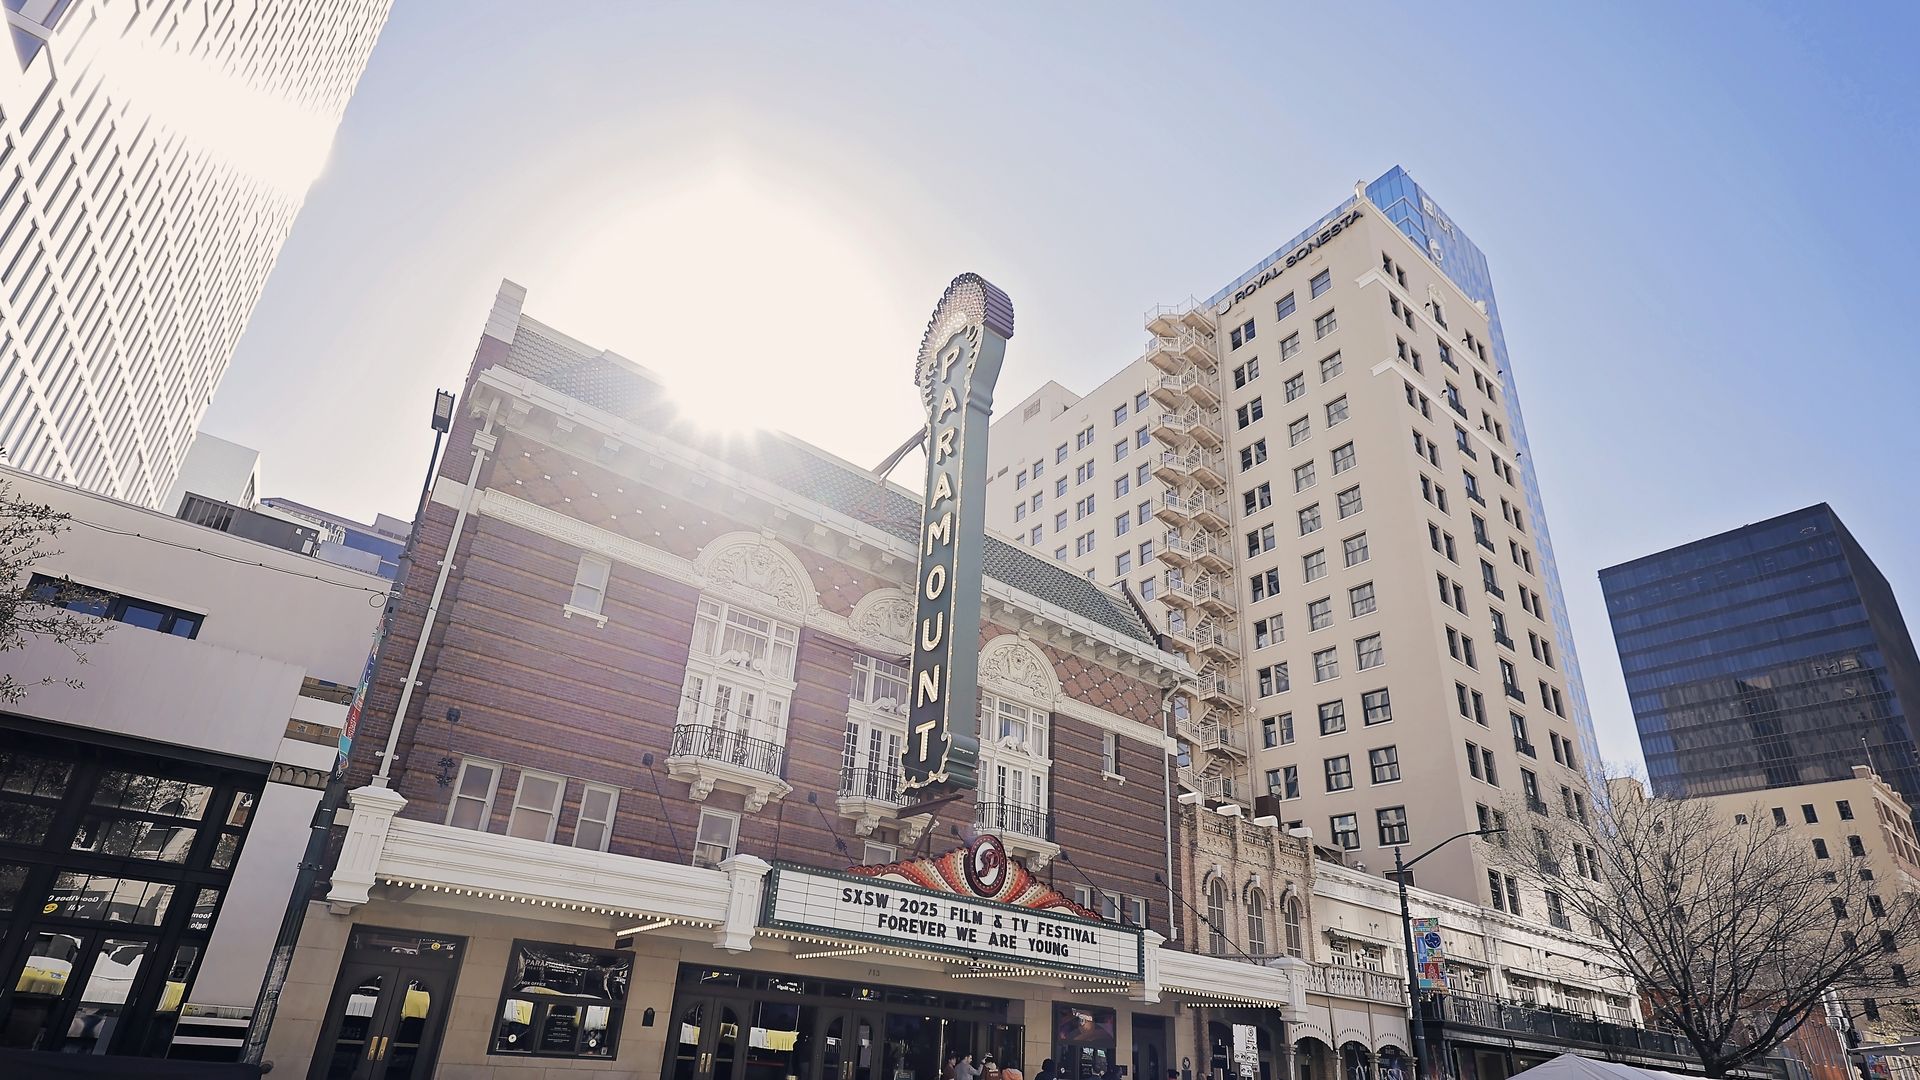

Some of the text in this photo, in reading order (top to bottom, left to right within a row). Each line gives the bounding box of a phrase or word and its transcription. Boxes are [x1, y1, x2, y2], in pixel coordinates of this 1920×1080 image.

[1235, 210, 1363, 304] ROYAL SONESTA
[915, 345, 961, 763] PARAMOUNT
[842, 888, 1098, 944] SXSW 2025 FILM & TV FESTIVAL
[878, 913, 1069, 957] FOREVER WE ARE YOUNG
